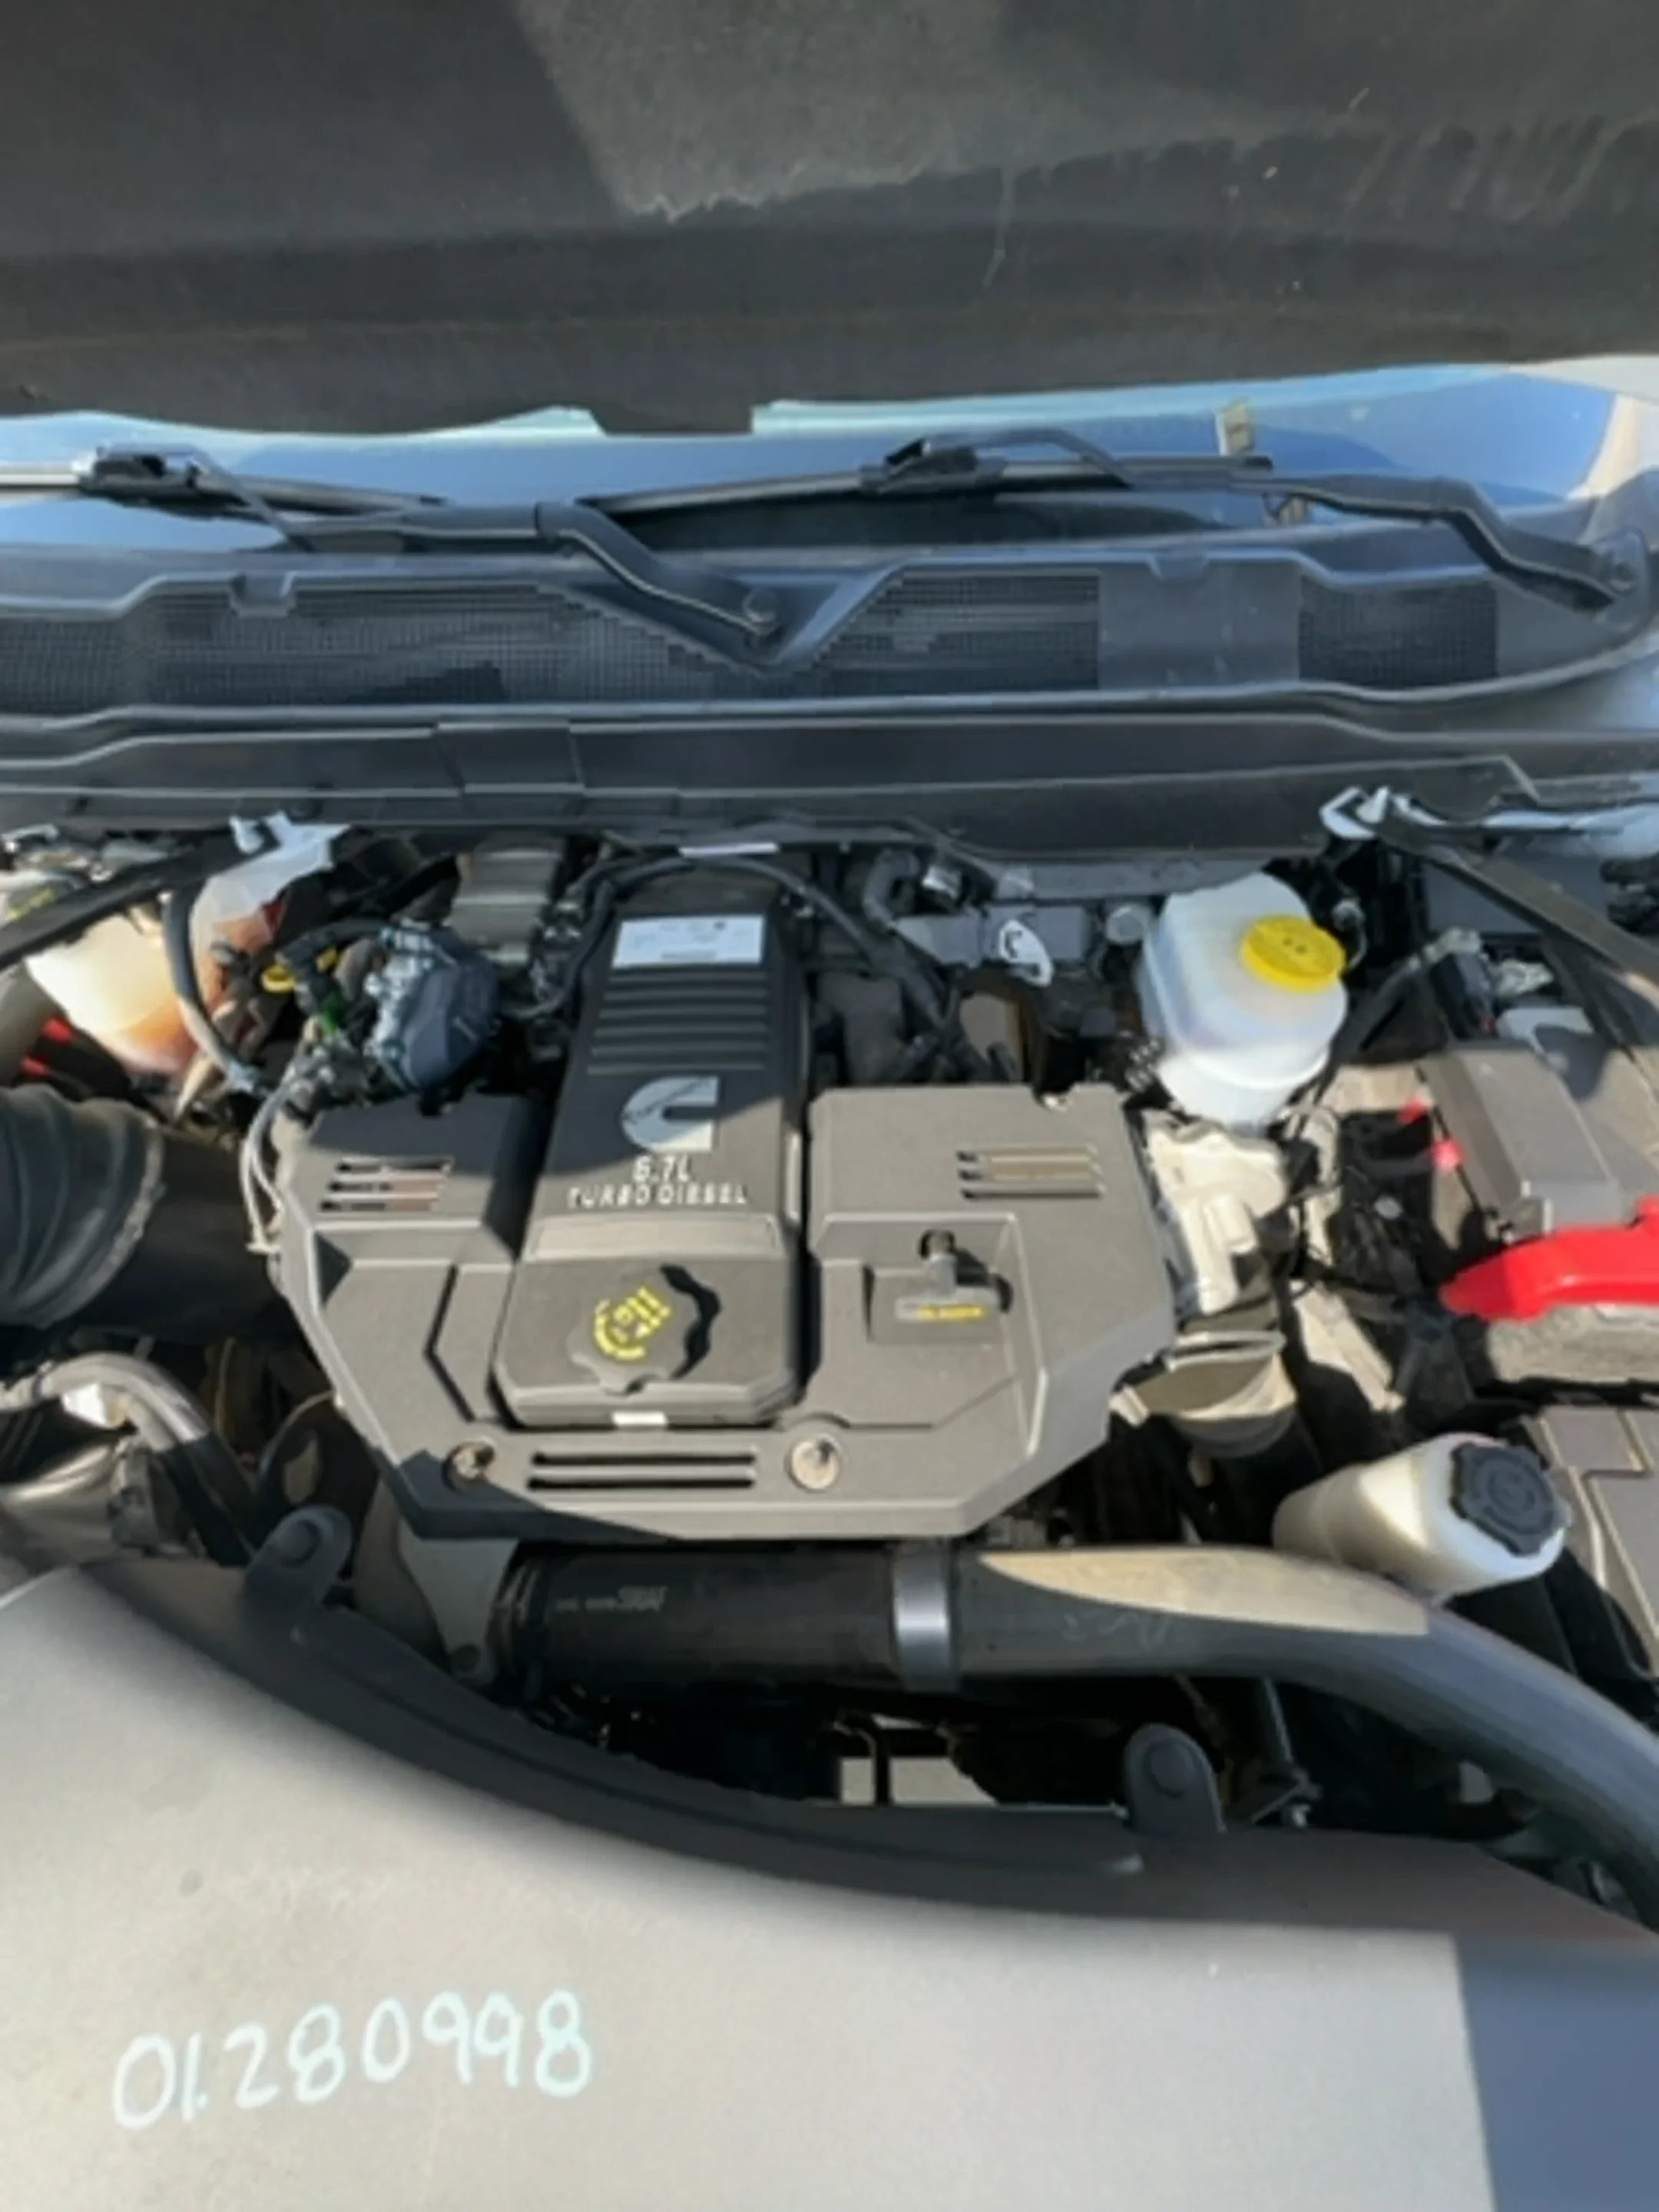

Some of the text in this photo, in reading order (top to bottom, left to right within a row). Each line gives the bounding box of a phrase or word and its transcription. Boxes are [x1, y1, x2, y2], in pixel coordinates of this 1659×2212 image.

[632, 1154, 690, 1183] 6.7L
[567, 1182, 748, 1210] TURBO DIESEL
